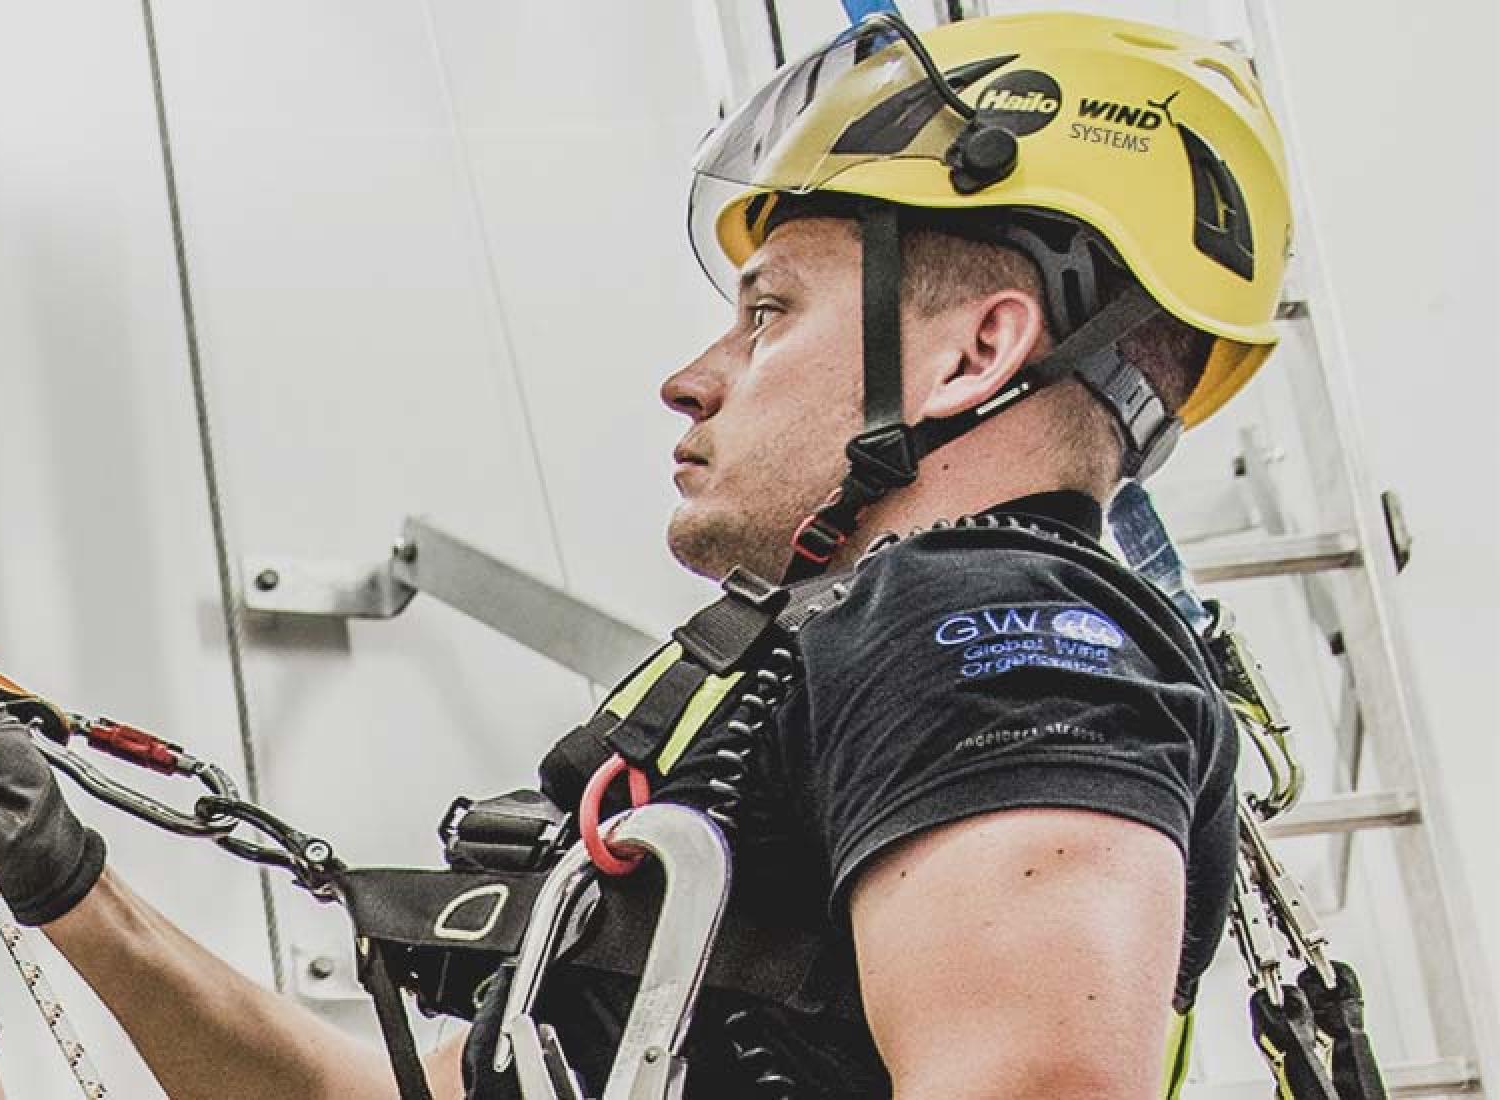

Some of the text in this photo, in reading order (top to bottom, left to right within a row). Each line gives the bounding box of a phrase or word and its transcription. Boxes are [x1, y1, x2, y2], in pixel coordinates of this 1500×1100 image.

[978, 89, 1058, 113] Hailo
[1078, 97, 1162, 130] WIND
[1069, 122, 1151, 153] SYSTEMS
[963, 637, 1110, 662] Global Wind
